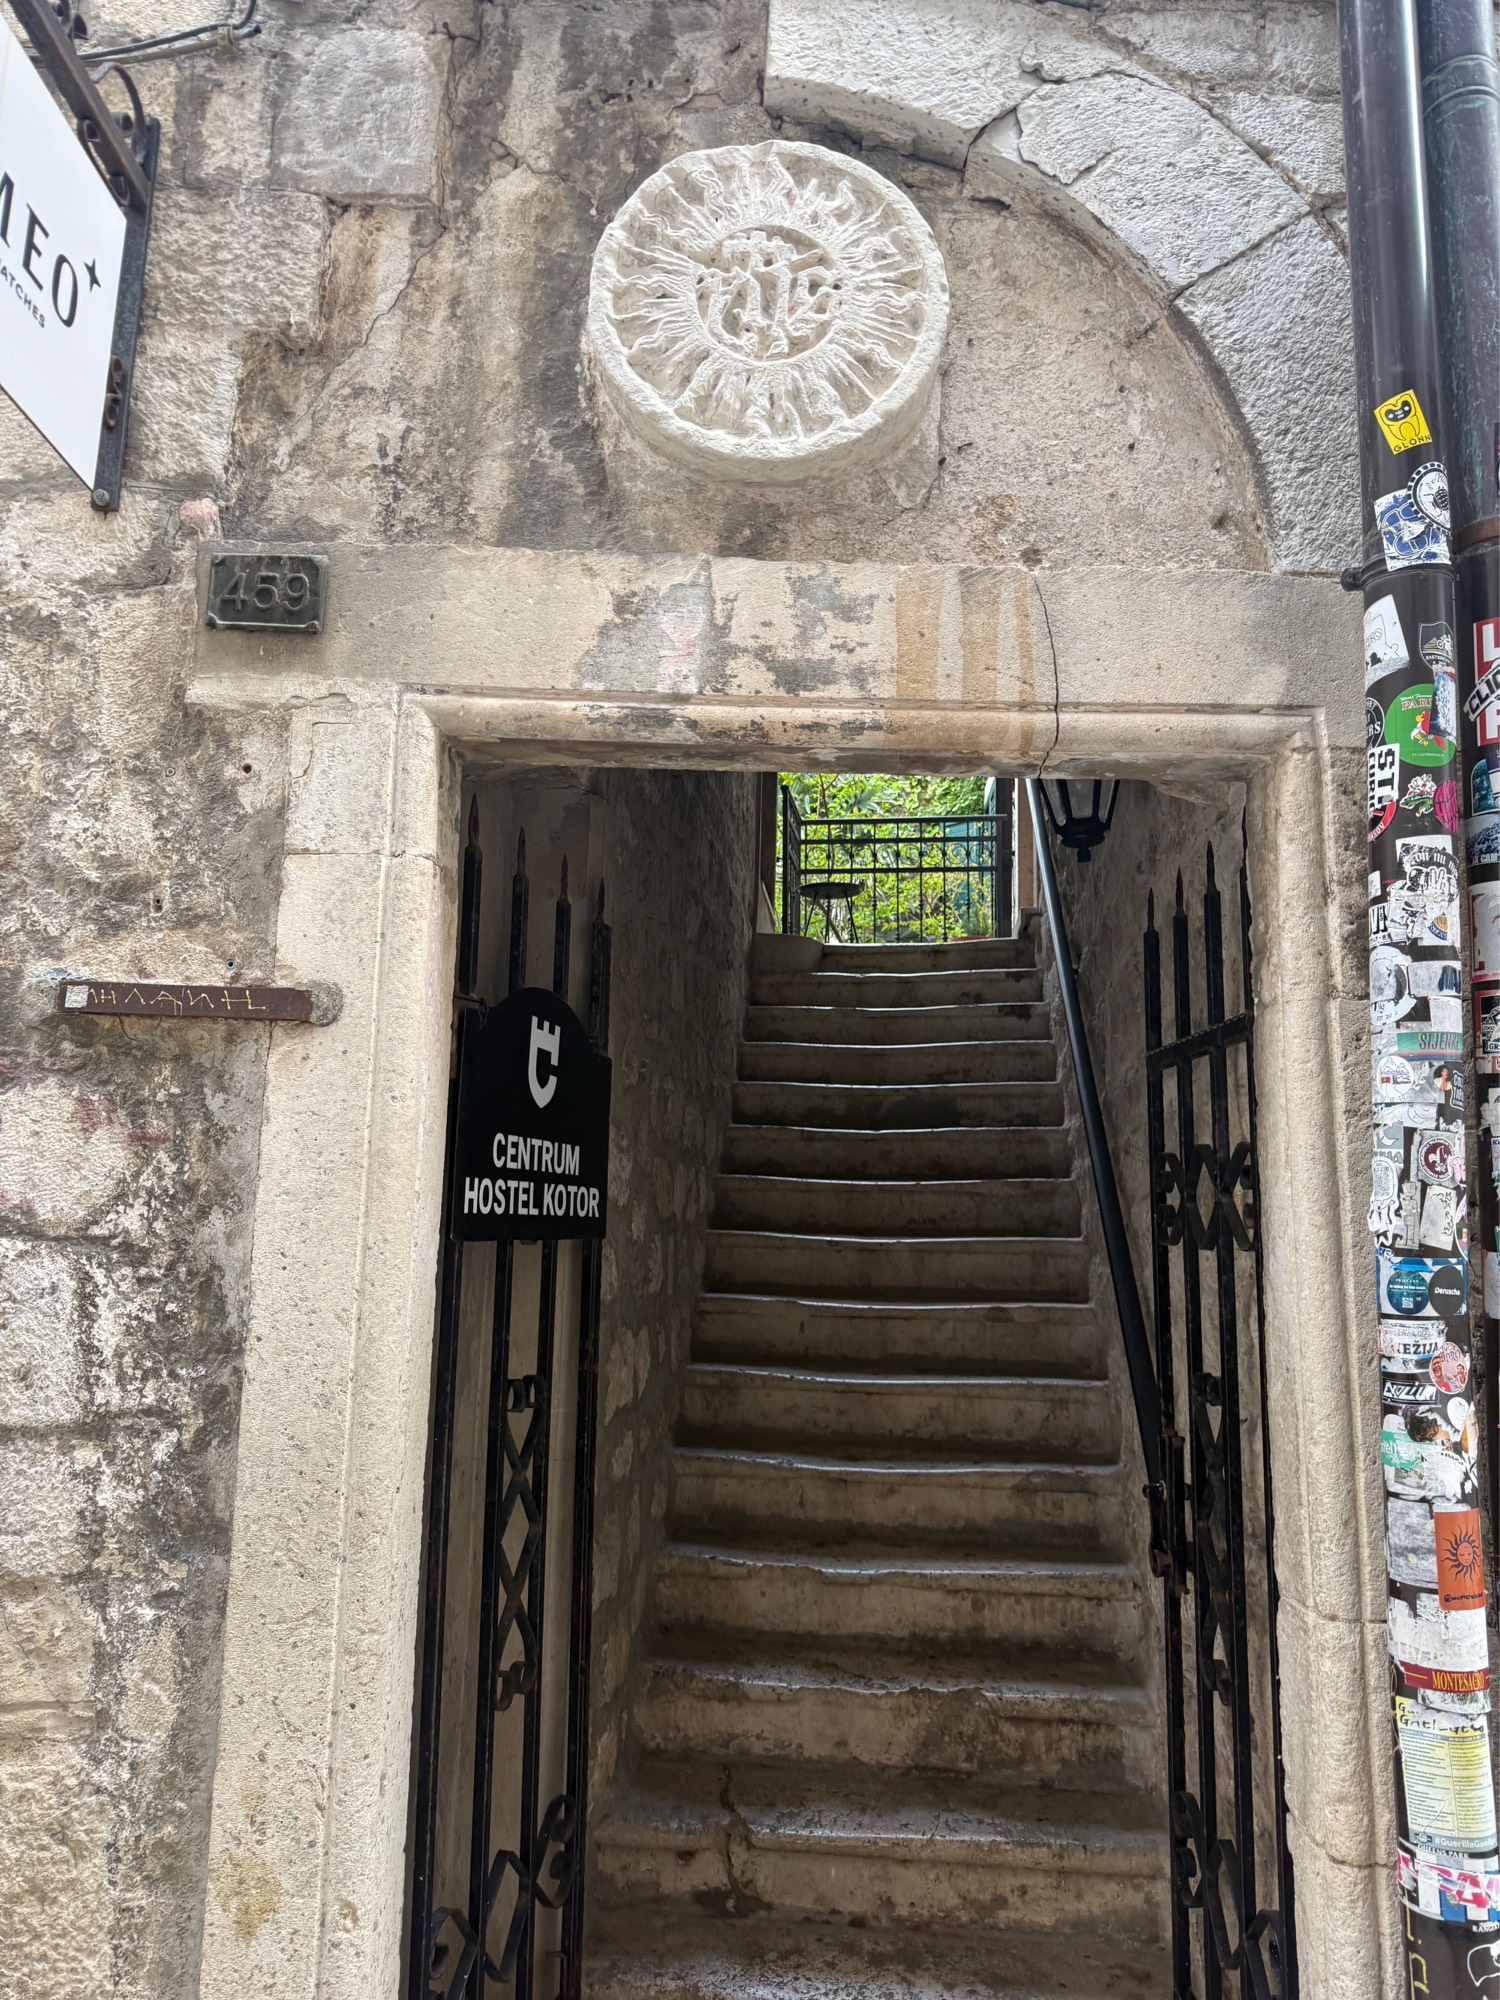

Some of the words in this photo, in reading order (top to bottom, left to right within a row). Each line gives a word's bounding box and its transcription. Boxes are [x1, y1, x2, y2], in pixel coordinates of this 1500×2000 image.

[216, 572, 309, 611] 459
[1401, 698, 1432, 711] PAR
[492, 1132, 580, 1176] CENTRUM
[463, 1176, 539, 1216] HOSTEL
[542, 1182, 600, 1218] KOTOR
[1417, 1843, 1447, 1854] QUEENS
[1449, 1850, 1469, 1859] PARK
